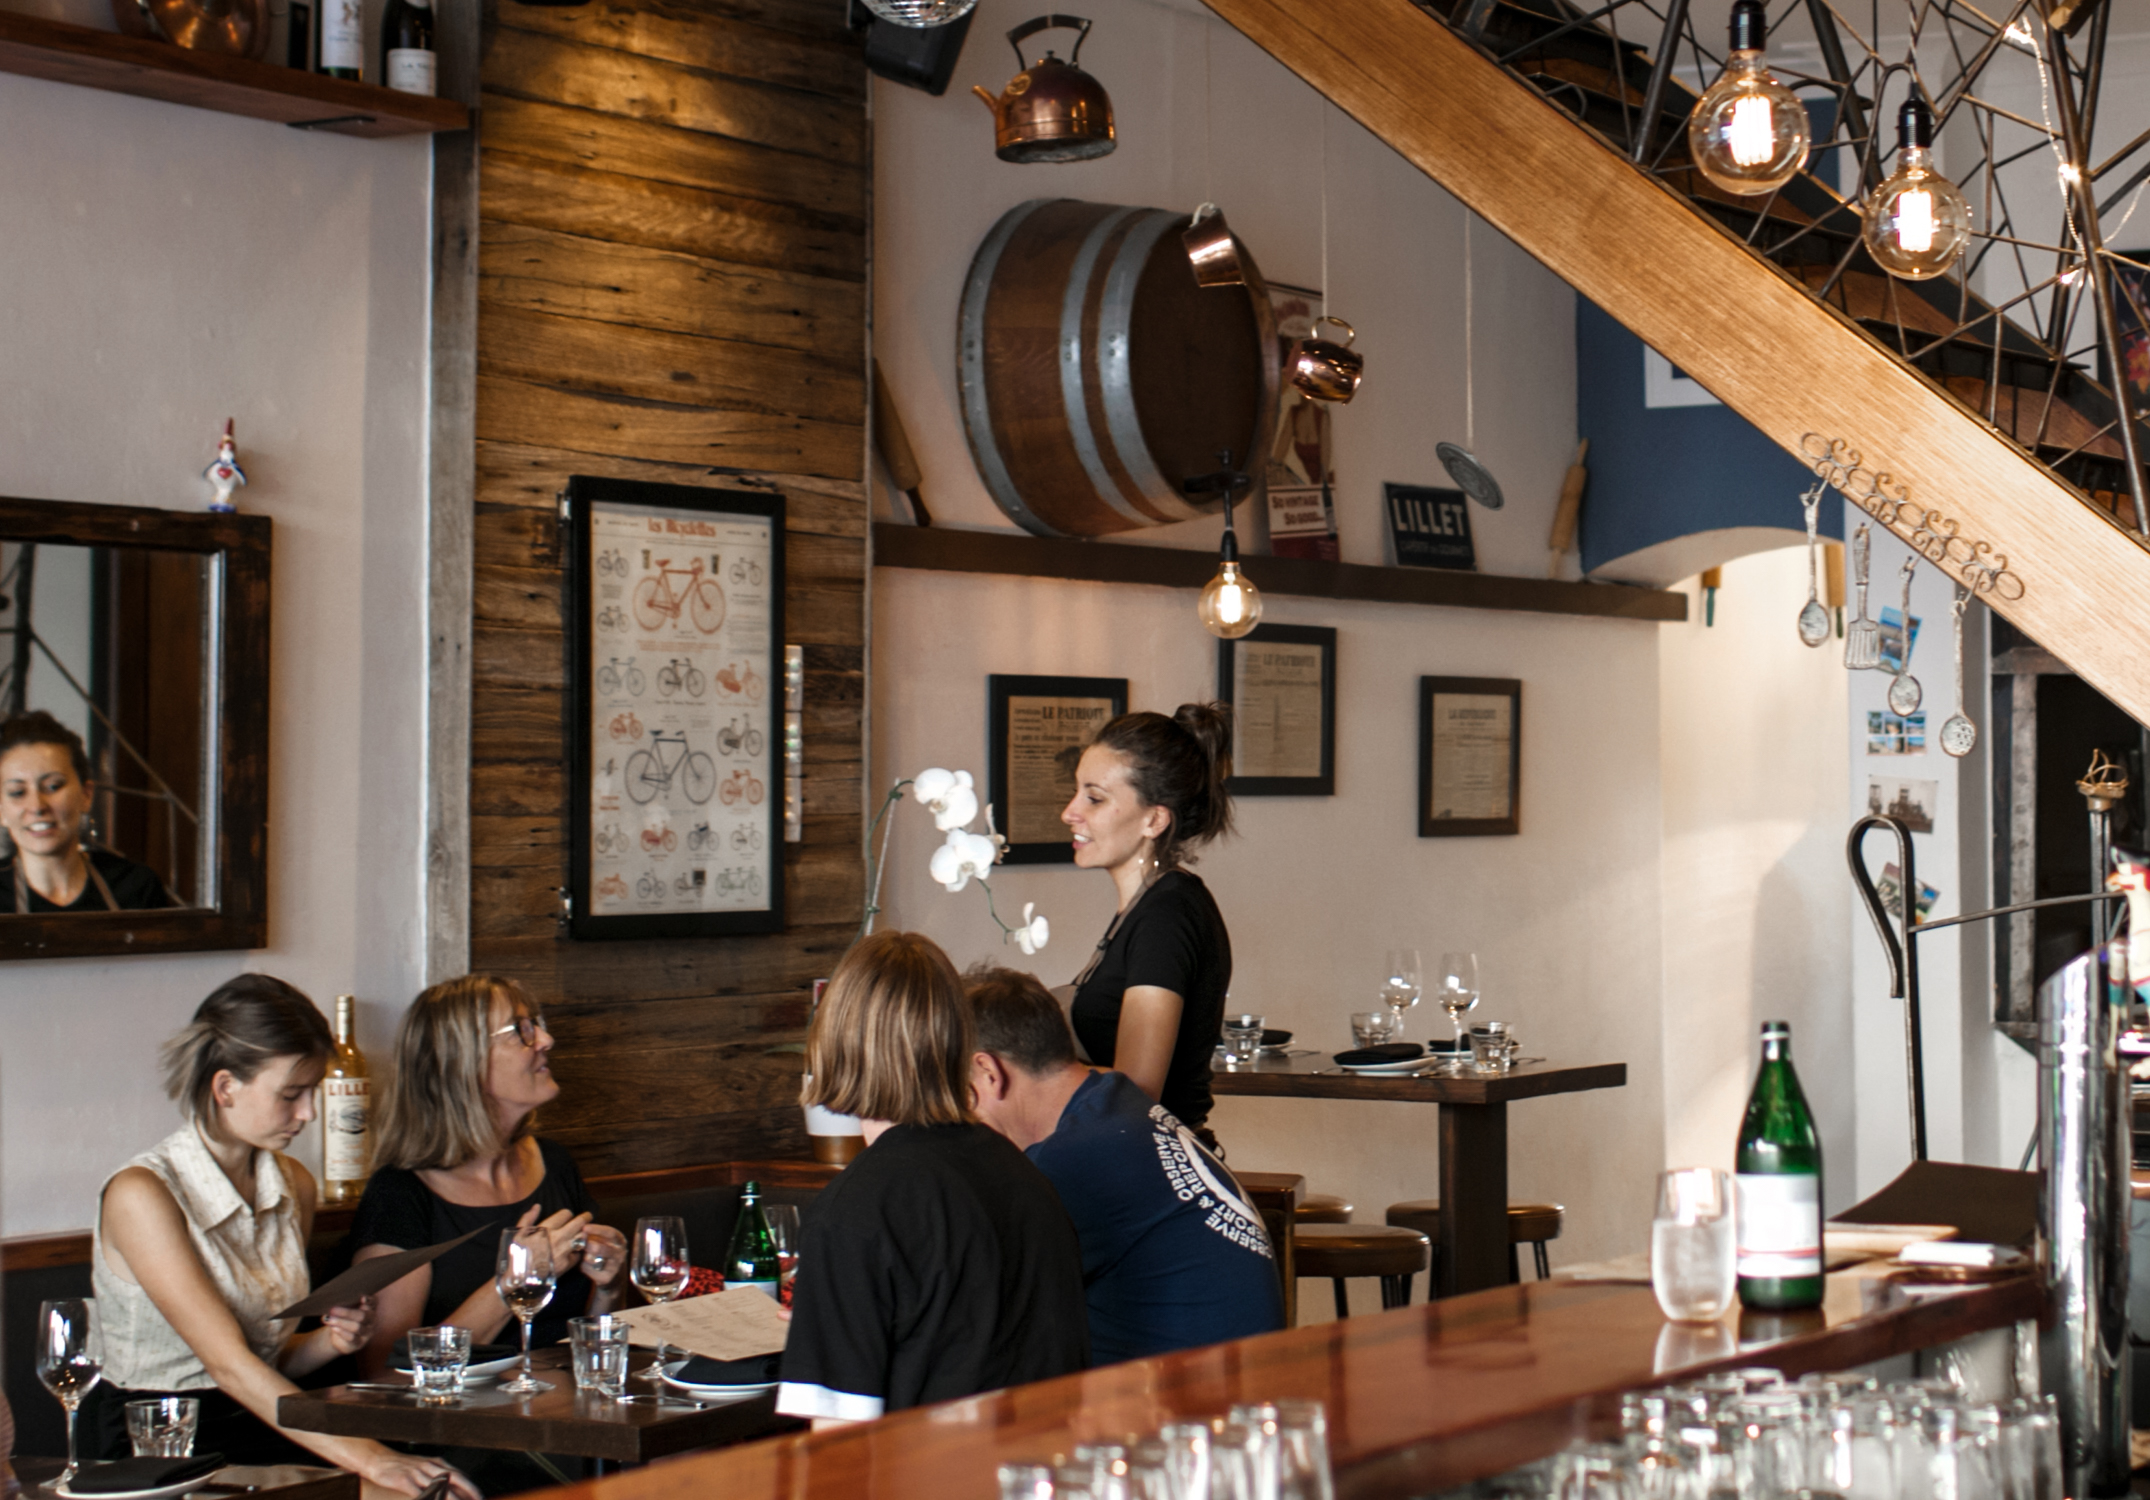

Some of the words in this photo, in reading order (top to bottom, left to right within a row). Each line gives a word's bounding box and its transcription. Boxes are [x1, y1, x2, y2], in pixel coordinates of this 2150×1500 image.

[1392, 498, 1465, 537] LILLET
[1042, 706, 1055, 719] LE
[329, 1082, 372, 1096] LILLE
[1152, 1132, 1194, 1201] OBSERVE
[1166, 1135, 1207, 1194] REPORT
[1198, 1195, 1215, 1209] &
[1205, 1213, 1273, 1259] BSERVE
